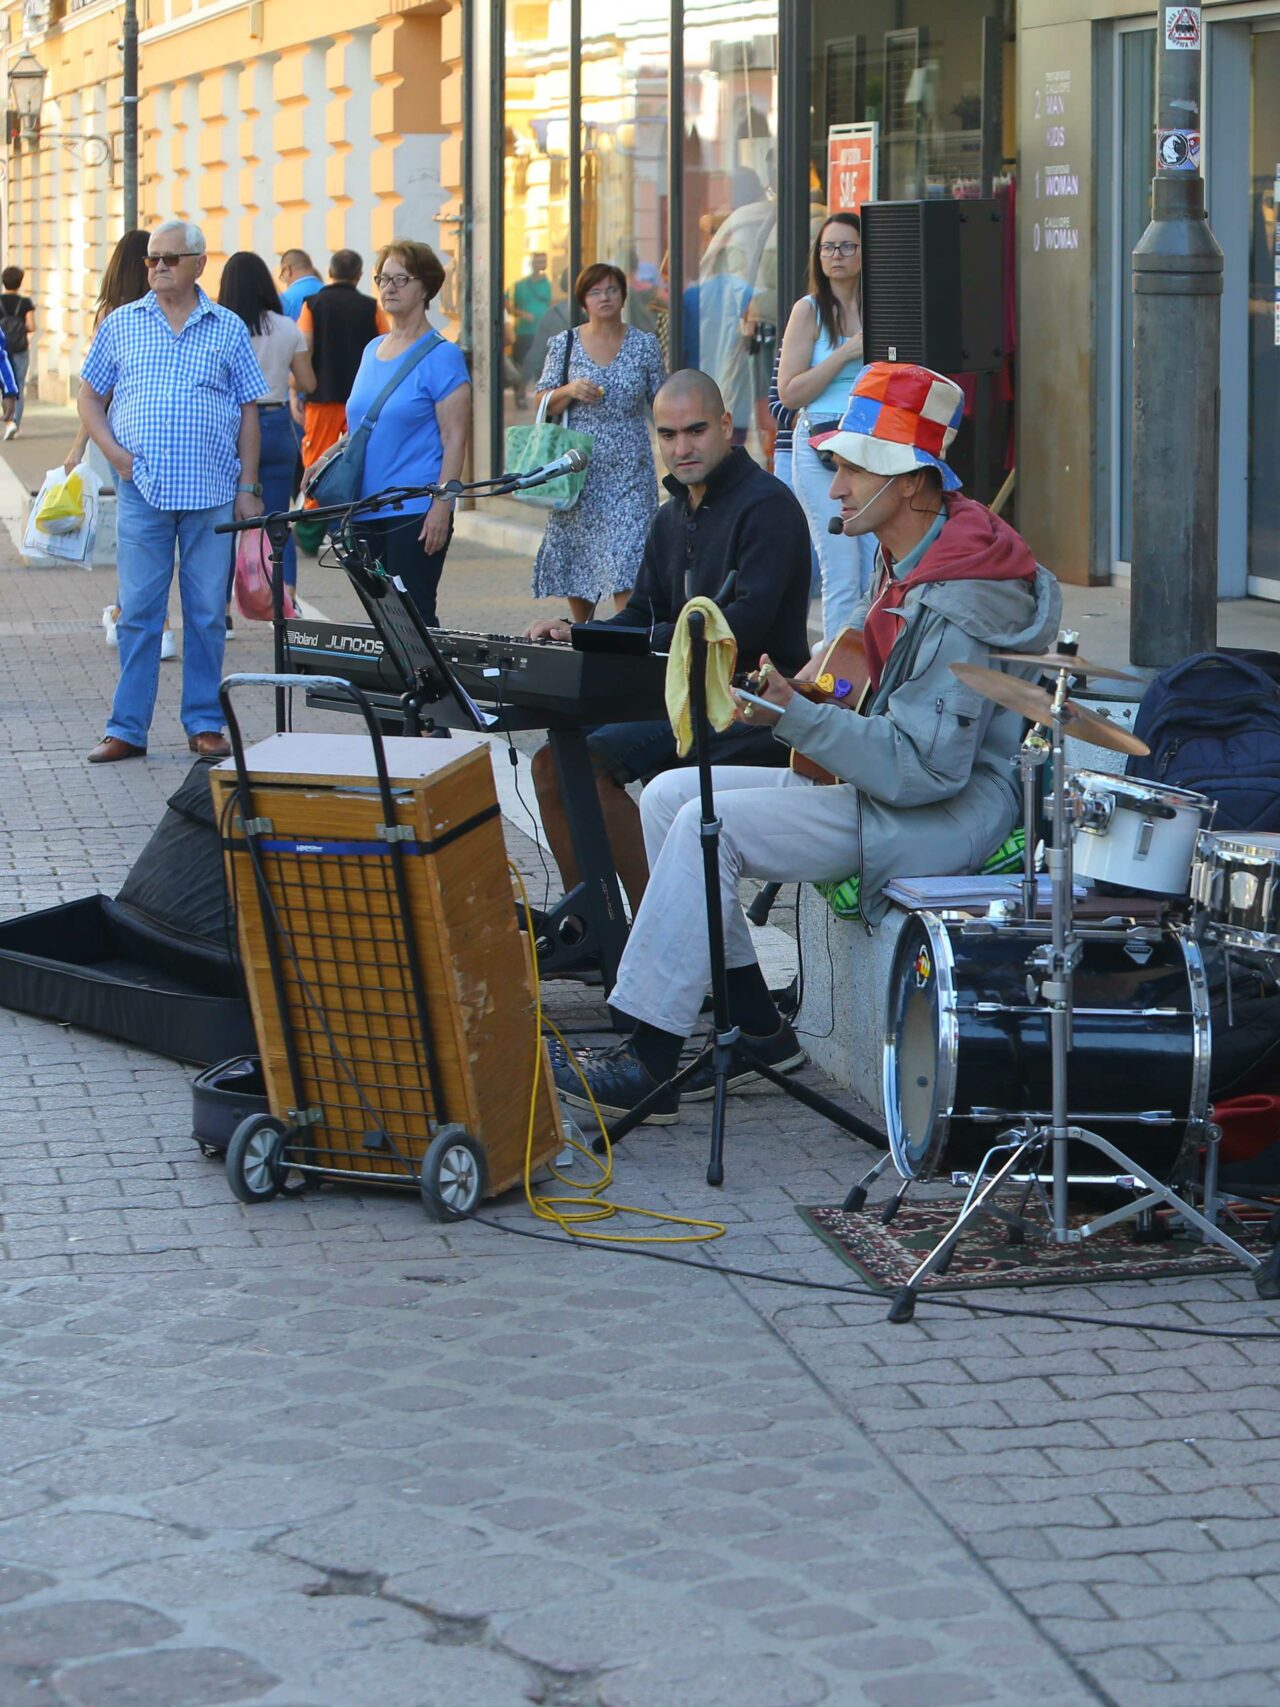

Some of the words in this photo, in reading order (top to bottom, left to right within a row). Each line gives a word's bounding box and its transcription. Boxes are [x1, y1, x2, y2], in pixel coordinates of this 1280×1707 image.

[1045, 175, 1079, 196] WOMAN
[1045, 229, 1079, 249] WOMAN
[292, 630, 319, 647] Roland
